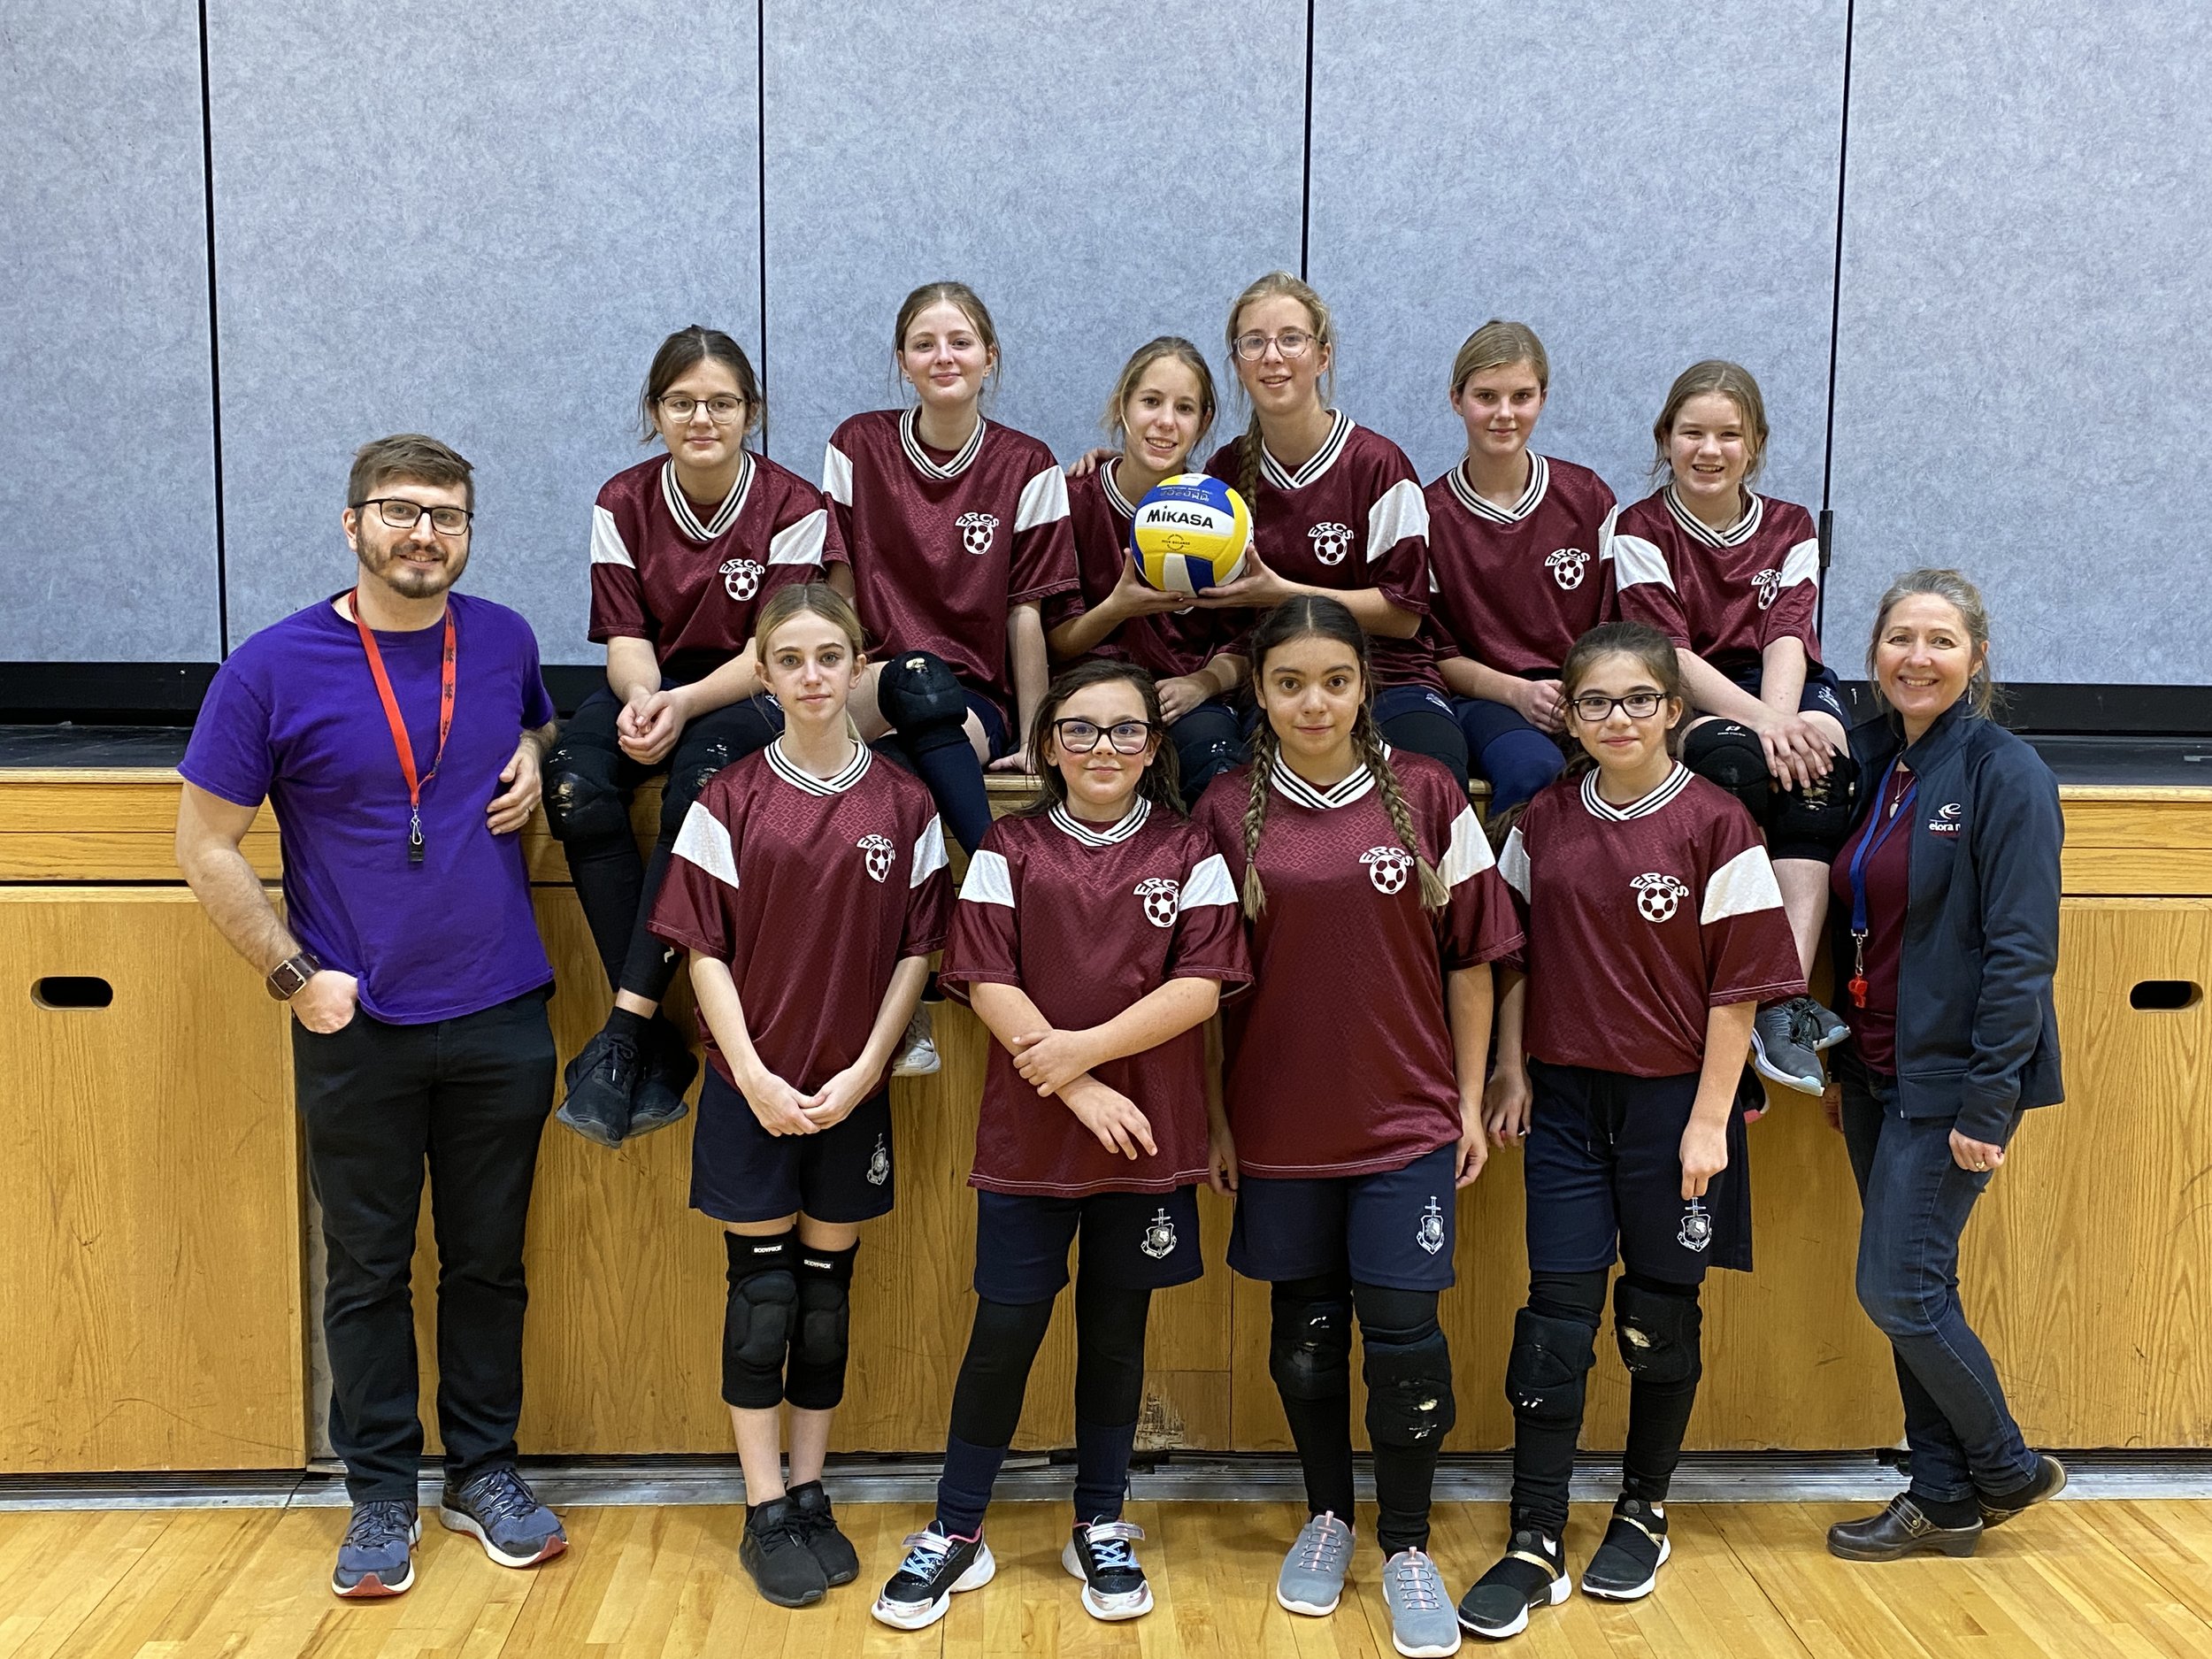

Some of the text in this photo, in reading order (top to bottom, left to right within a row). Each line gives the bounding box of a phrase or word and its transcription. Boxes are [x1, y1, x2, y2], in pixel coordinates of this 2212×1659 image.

[955, 511, 999, 528] ERCS
[1308, 522, 1354, 540] ERCS
[1544, 548, 1591, 566] ERCS
[718, 558, 765, 575] ERCS
[1359, 846, 1415, 867] ERCS
[1133, 877, 1179, 897] ERC
[1629, 872, 1690, 897] ERCS
